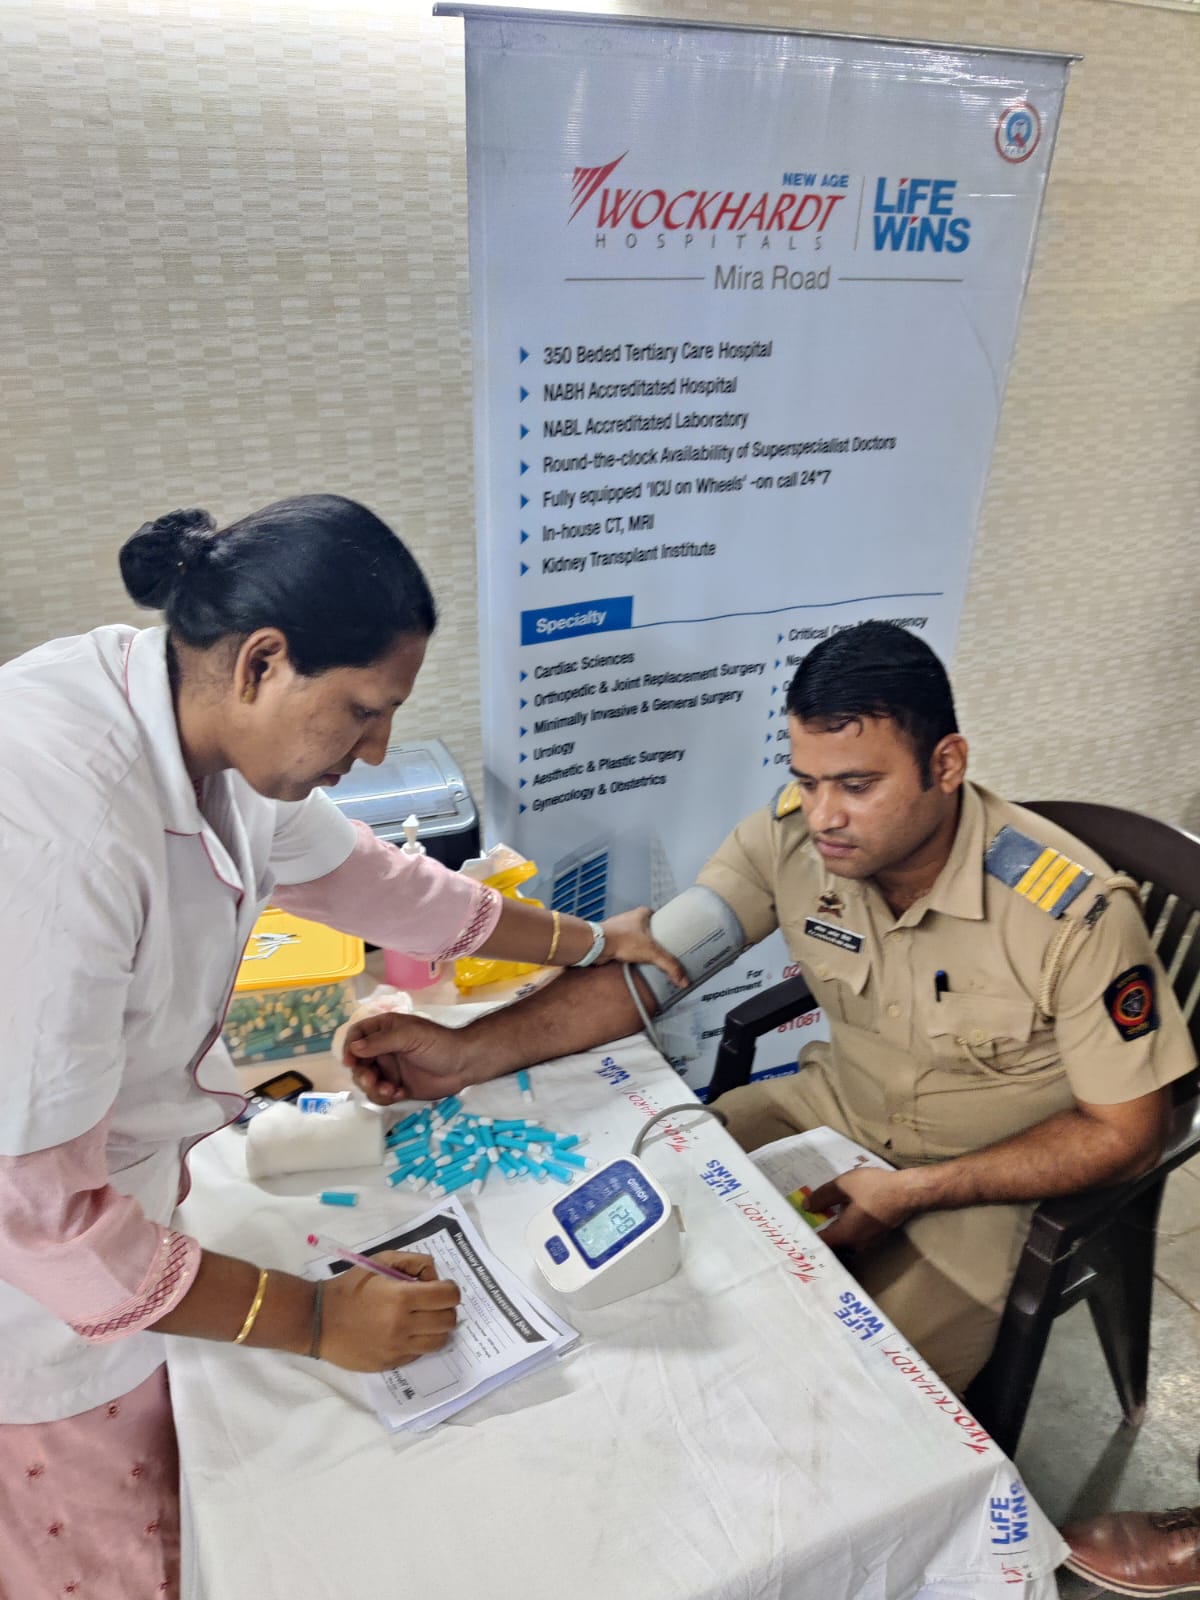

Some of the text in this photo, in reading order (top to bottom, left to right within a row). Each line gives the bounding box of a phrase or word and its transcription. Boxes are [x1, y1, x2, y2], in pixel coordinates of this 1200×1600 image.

[782, 172, 850, 188] NEW AGE
[597, 188, 846, 232] WOCKHARDT
[595, 233, 823, 250] HOSPITALS
[713, 264, 831, 290] Mira Road
[543, 340, 773, 365] 350 Beded Tertiary Care Hospital
[543, 382, 585, 402] NABH
[679, 376, 738, 397] Hospital
[543, 419, 582, 438] NABL
[675, 411, 750, 431] Laboratory
[543, 436, 897, 473] Round-the-clock Availability of Superspecialist Doctors
[542, 490, 576, 508] Fully
[579, 483, 642, 506] equipped
[674, 481, 692, 495] on
[750, 475, 773, 490] -on
[777, 472, 800, 488] call
[542, 514, 655, 542] In-house CT, MRI
[542, 542, 717, 574] Kidney Transplant Institute
[535, 610, 607, 634] Specialty
[788, 625, 830, 641] Critical
[534, 653, 635, 680] Cardiac Sciences
[534, 662, 767, 707] Orthopedic & Joint Replacement Surgery
[533, 690, 745, 734] Minimally Invasive & General Surgery
[533, 741, 576, 760] Urology
[532, 749, 687, 787] Aesthetic & Plastic Surgery
[532, 774, 668, 812] Gynecology & Obstetrics
[746, 969, 764, 980] For
[701, 981, 762, 1001] appointment
[620, 1090, 688, 1144] WOCHARDT
[734, 1202, 816, 1272] WOCKHARDT
[881, 1346, 992, 1443] WOCKHARDT
